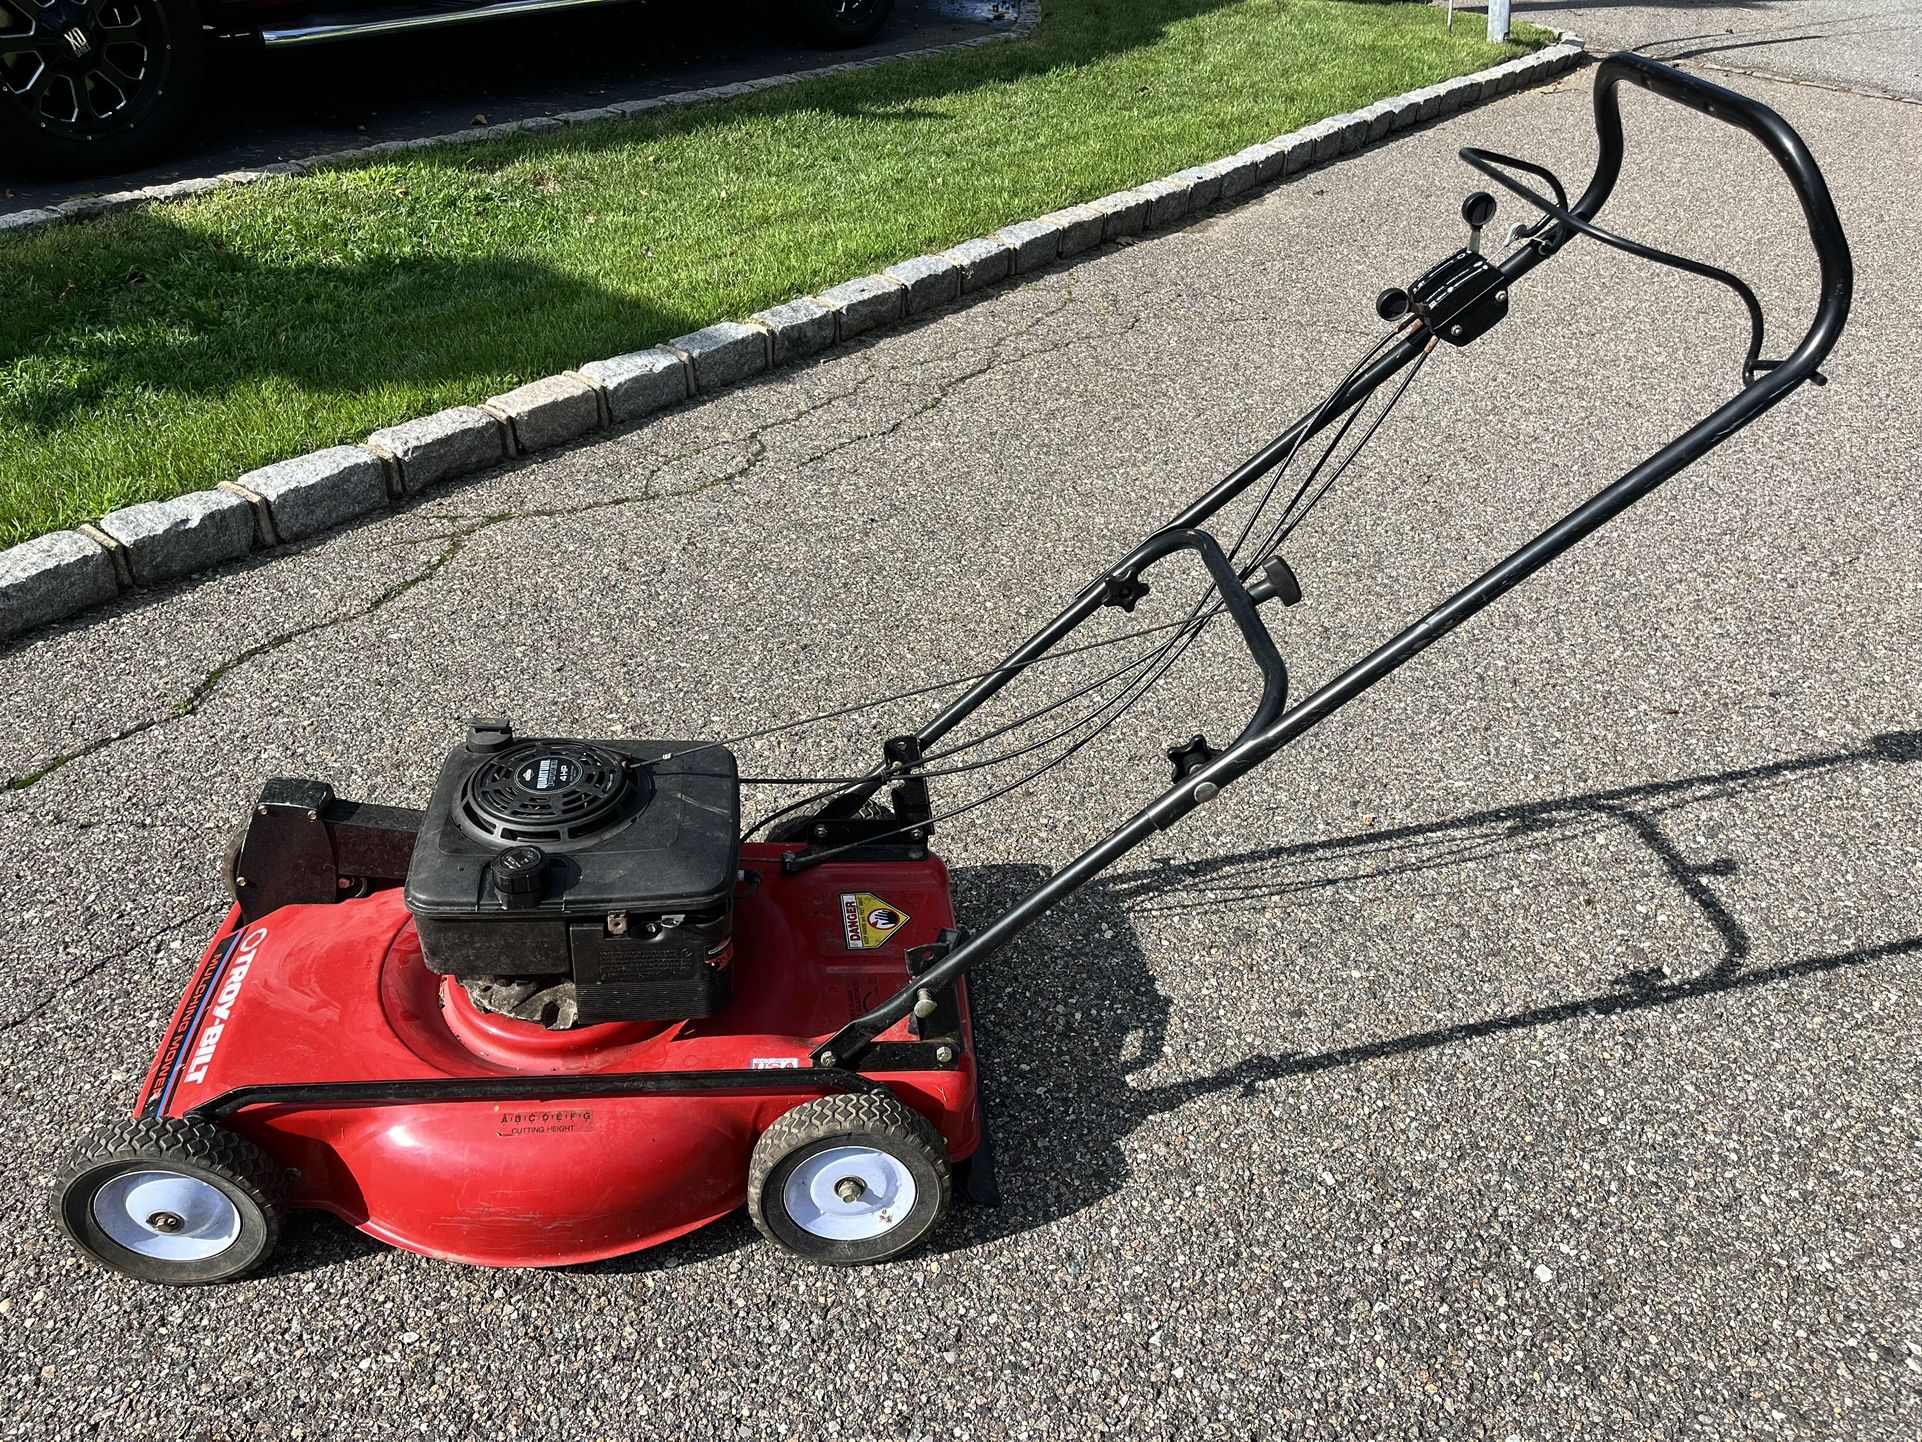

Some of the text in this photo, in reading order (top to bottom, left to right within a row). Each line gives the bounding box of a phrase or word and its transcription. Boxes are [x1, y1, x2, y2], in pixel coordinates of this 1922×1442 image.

[64, 27, 87, 50] XD
[845, 901, 861, 941] DANGER
[177, 952, 224, 1032] MULCHING
[184, 948, 258, 1084] TROY-BILT
[511, 1126, 545, 1134] CUTTING
